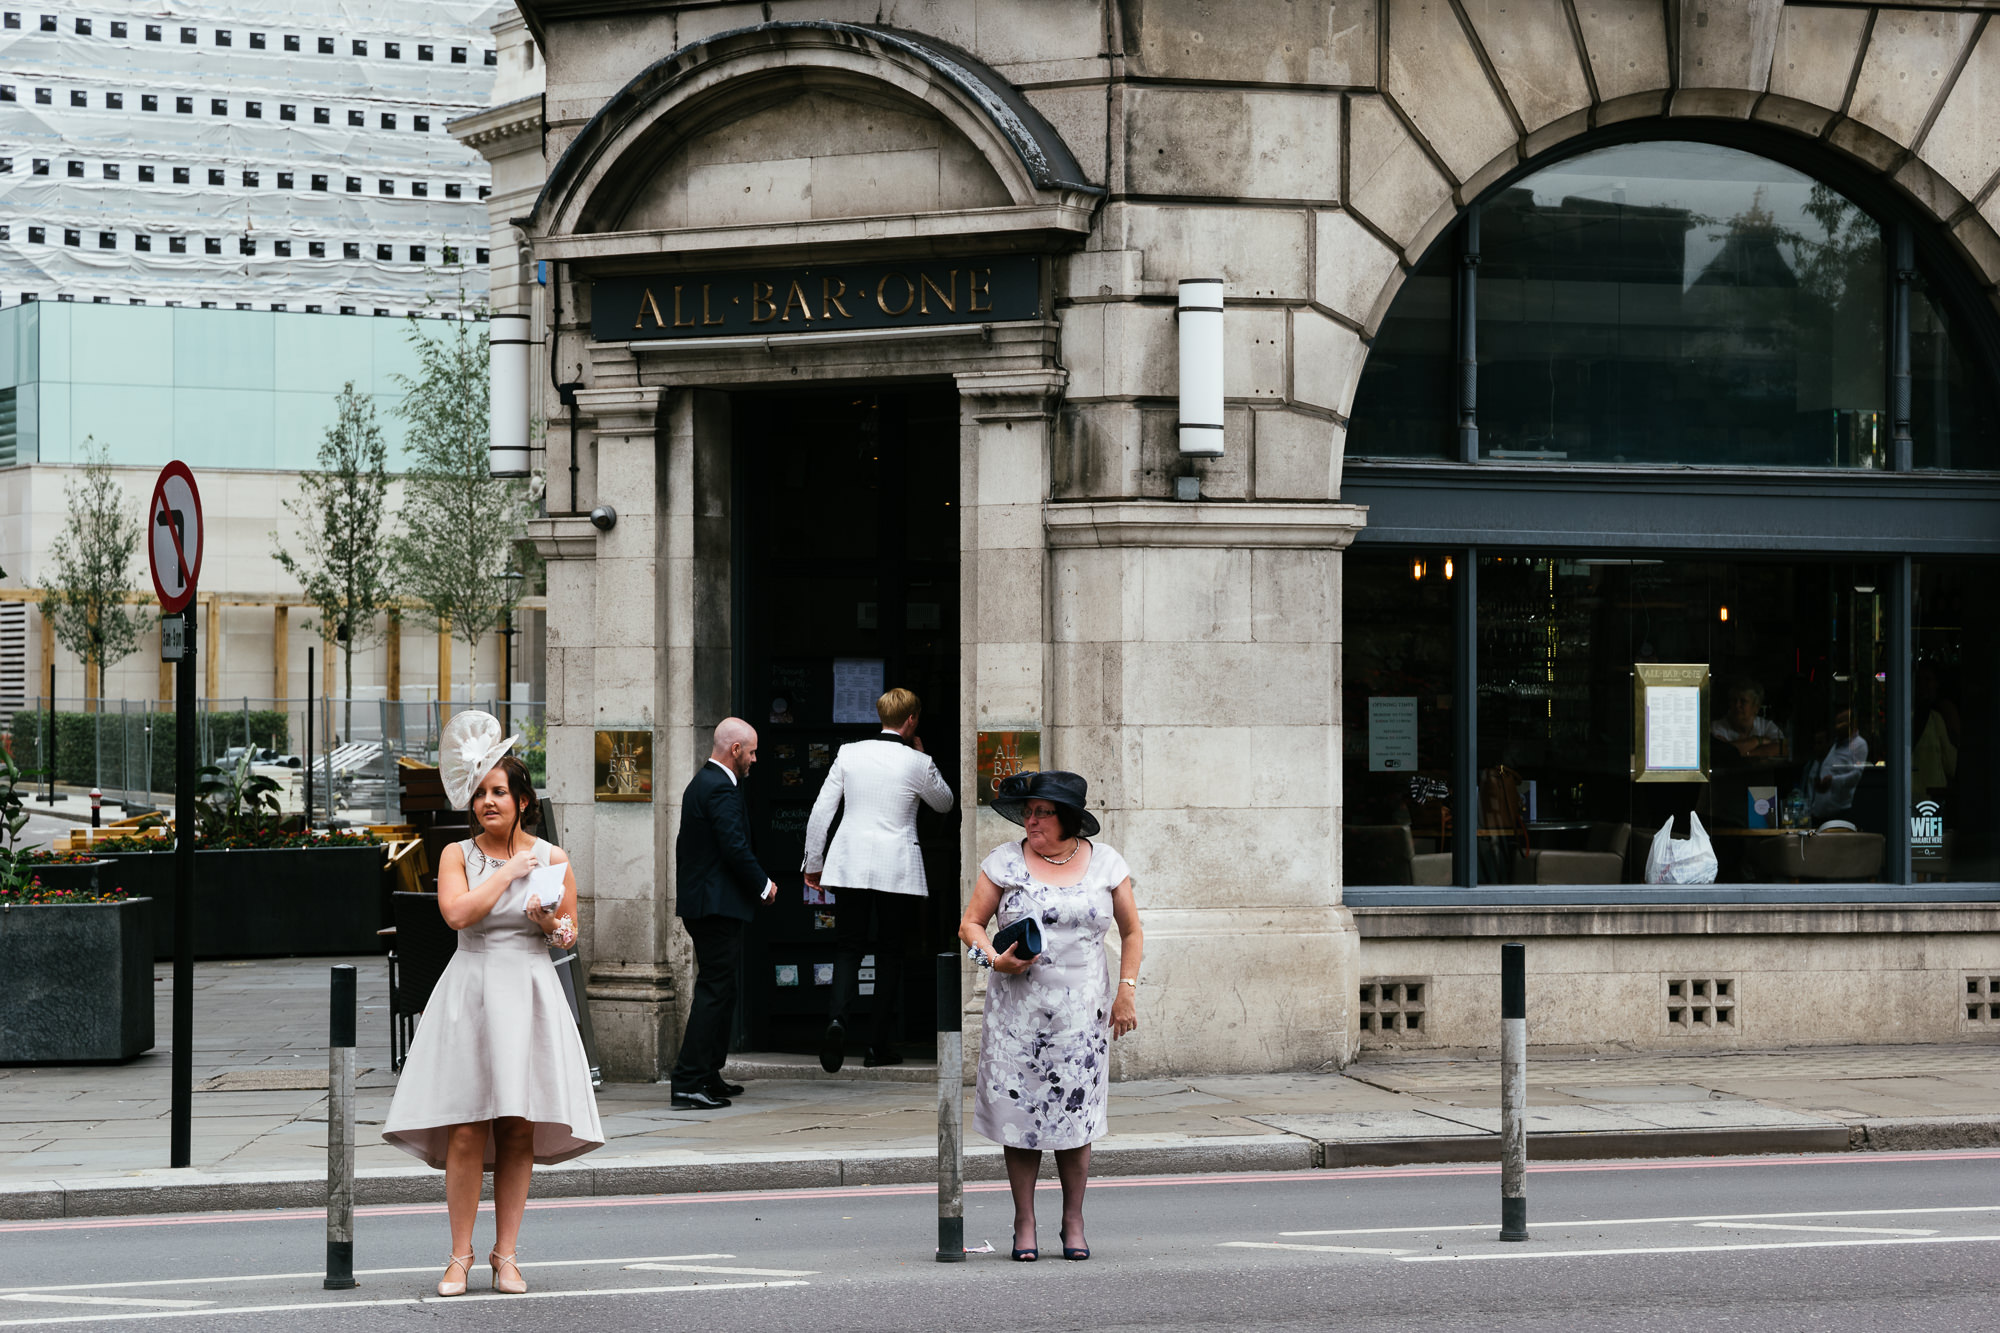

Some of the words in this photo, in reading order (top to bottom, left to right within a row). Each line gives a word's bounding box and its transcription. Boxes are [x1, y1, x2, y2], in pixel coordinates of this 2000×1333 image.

[634, 284, 725, 329] ALL
[750, 276, 854, 323] BAR
[876, 267, 993, 316] ONE
[1645, 669, 1660, 678] ALL
[1663, 670, 1679, 678] BAR
[1682, 670, 1701, 679] ONE
[610, 743, 637, 757] ALL
[994, 744, 1023, 759] ALL
[609, 758, 638, 773] BAR
[994, 760, 1024, 776] BAR
[606, 774, 640, 789] ONE
[1911, 817, 1942, 837] WiFi
